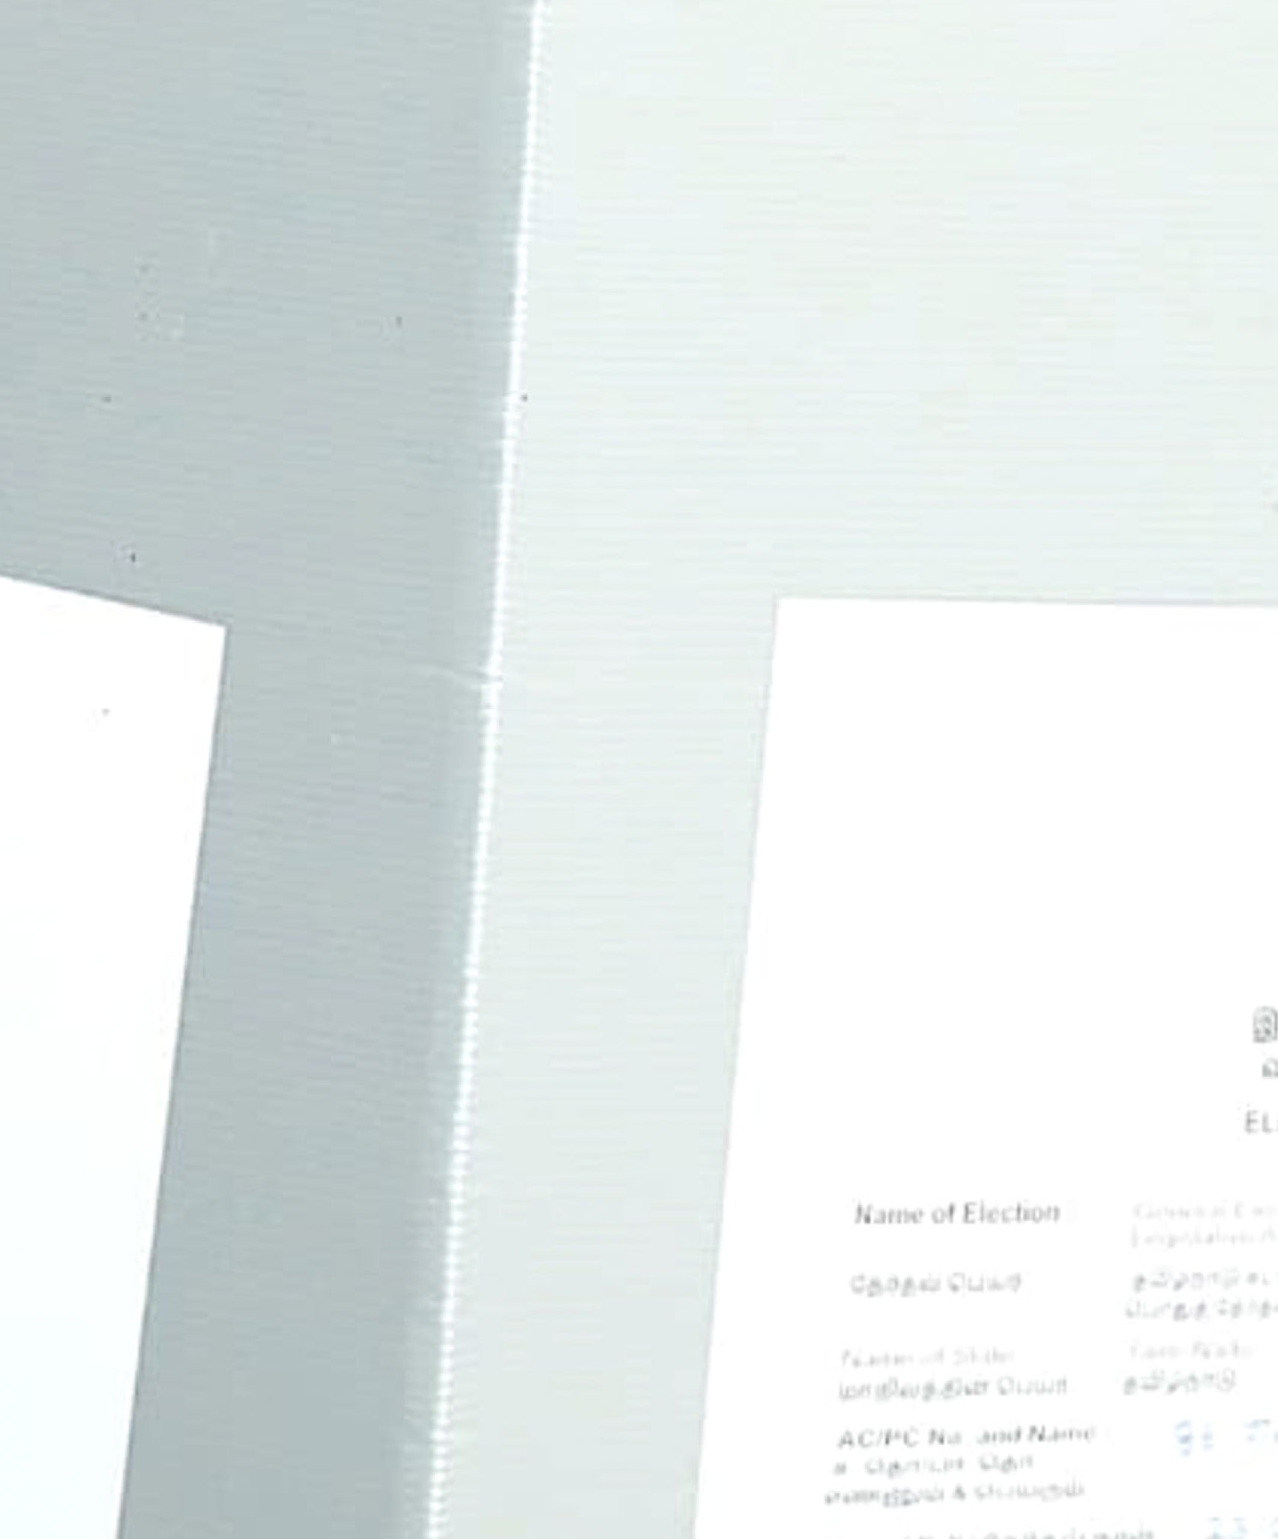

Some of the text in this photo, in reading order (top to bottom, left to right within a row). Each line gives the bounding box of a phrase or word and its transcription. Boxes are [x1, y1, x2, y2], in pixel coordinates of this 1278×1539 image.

[855, 1201, 1060, 1224] Name of Election
[837, 1427, 918, 1449] AC/PC
[977, 1426, 1022, 1444] and
[1027, 1425, 1094, 1442] Name
